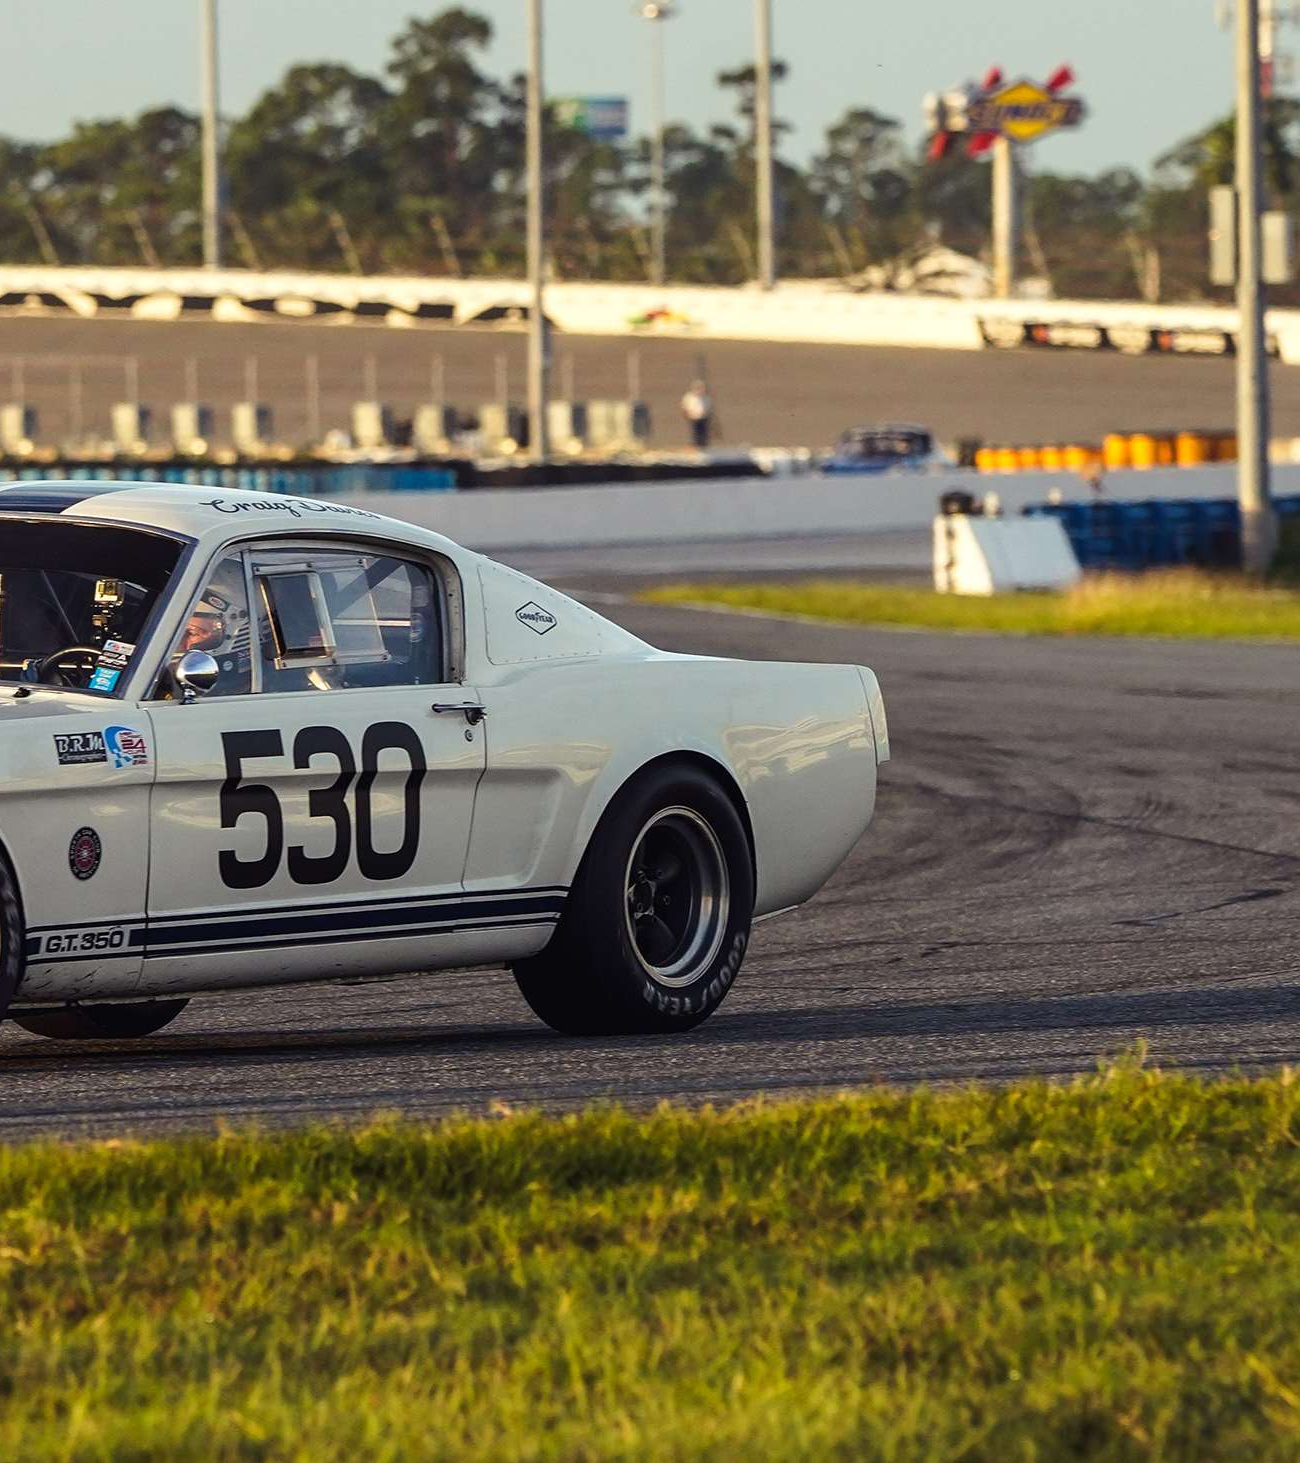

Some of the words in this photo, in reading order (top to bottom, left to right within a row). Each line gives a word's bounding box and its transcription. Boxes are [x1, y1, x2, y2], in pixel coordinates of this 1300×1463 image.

[199, 499, 301, 517] Craig
[518, 612, 553, 623] GOODYEAR
[218, 721, 427, 889] 530
